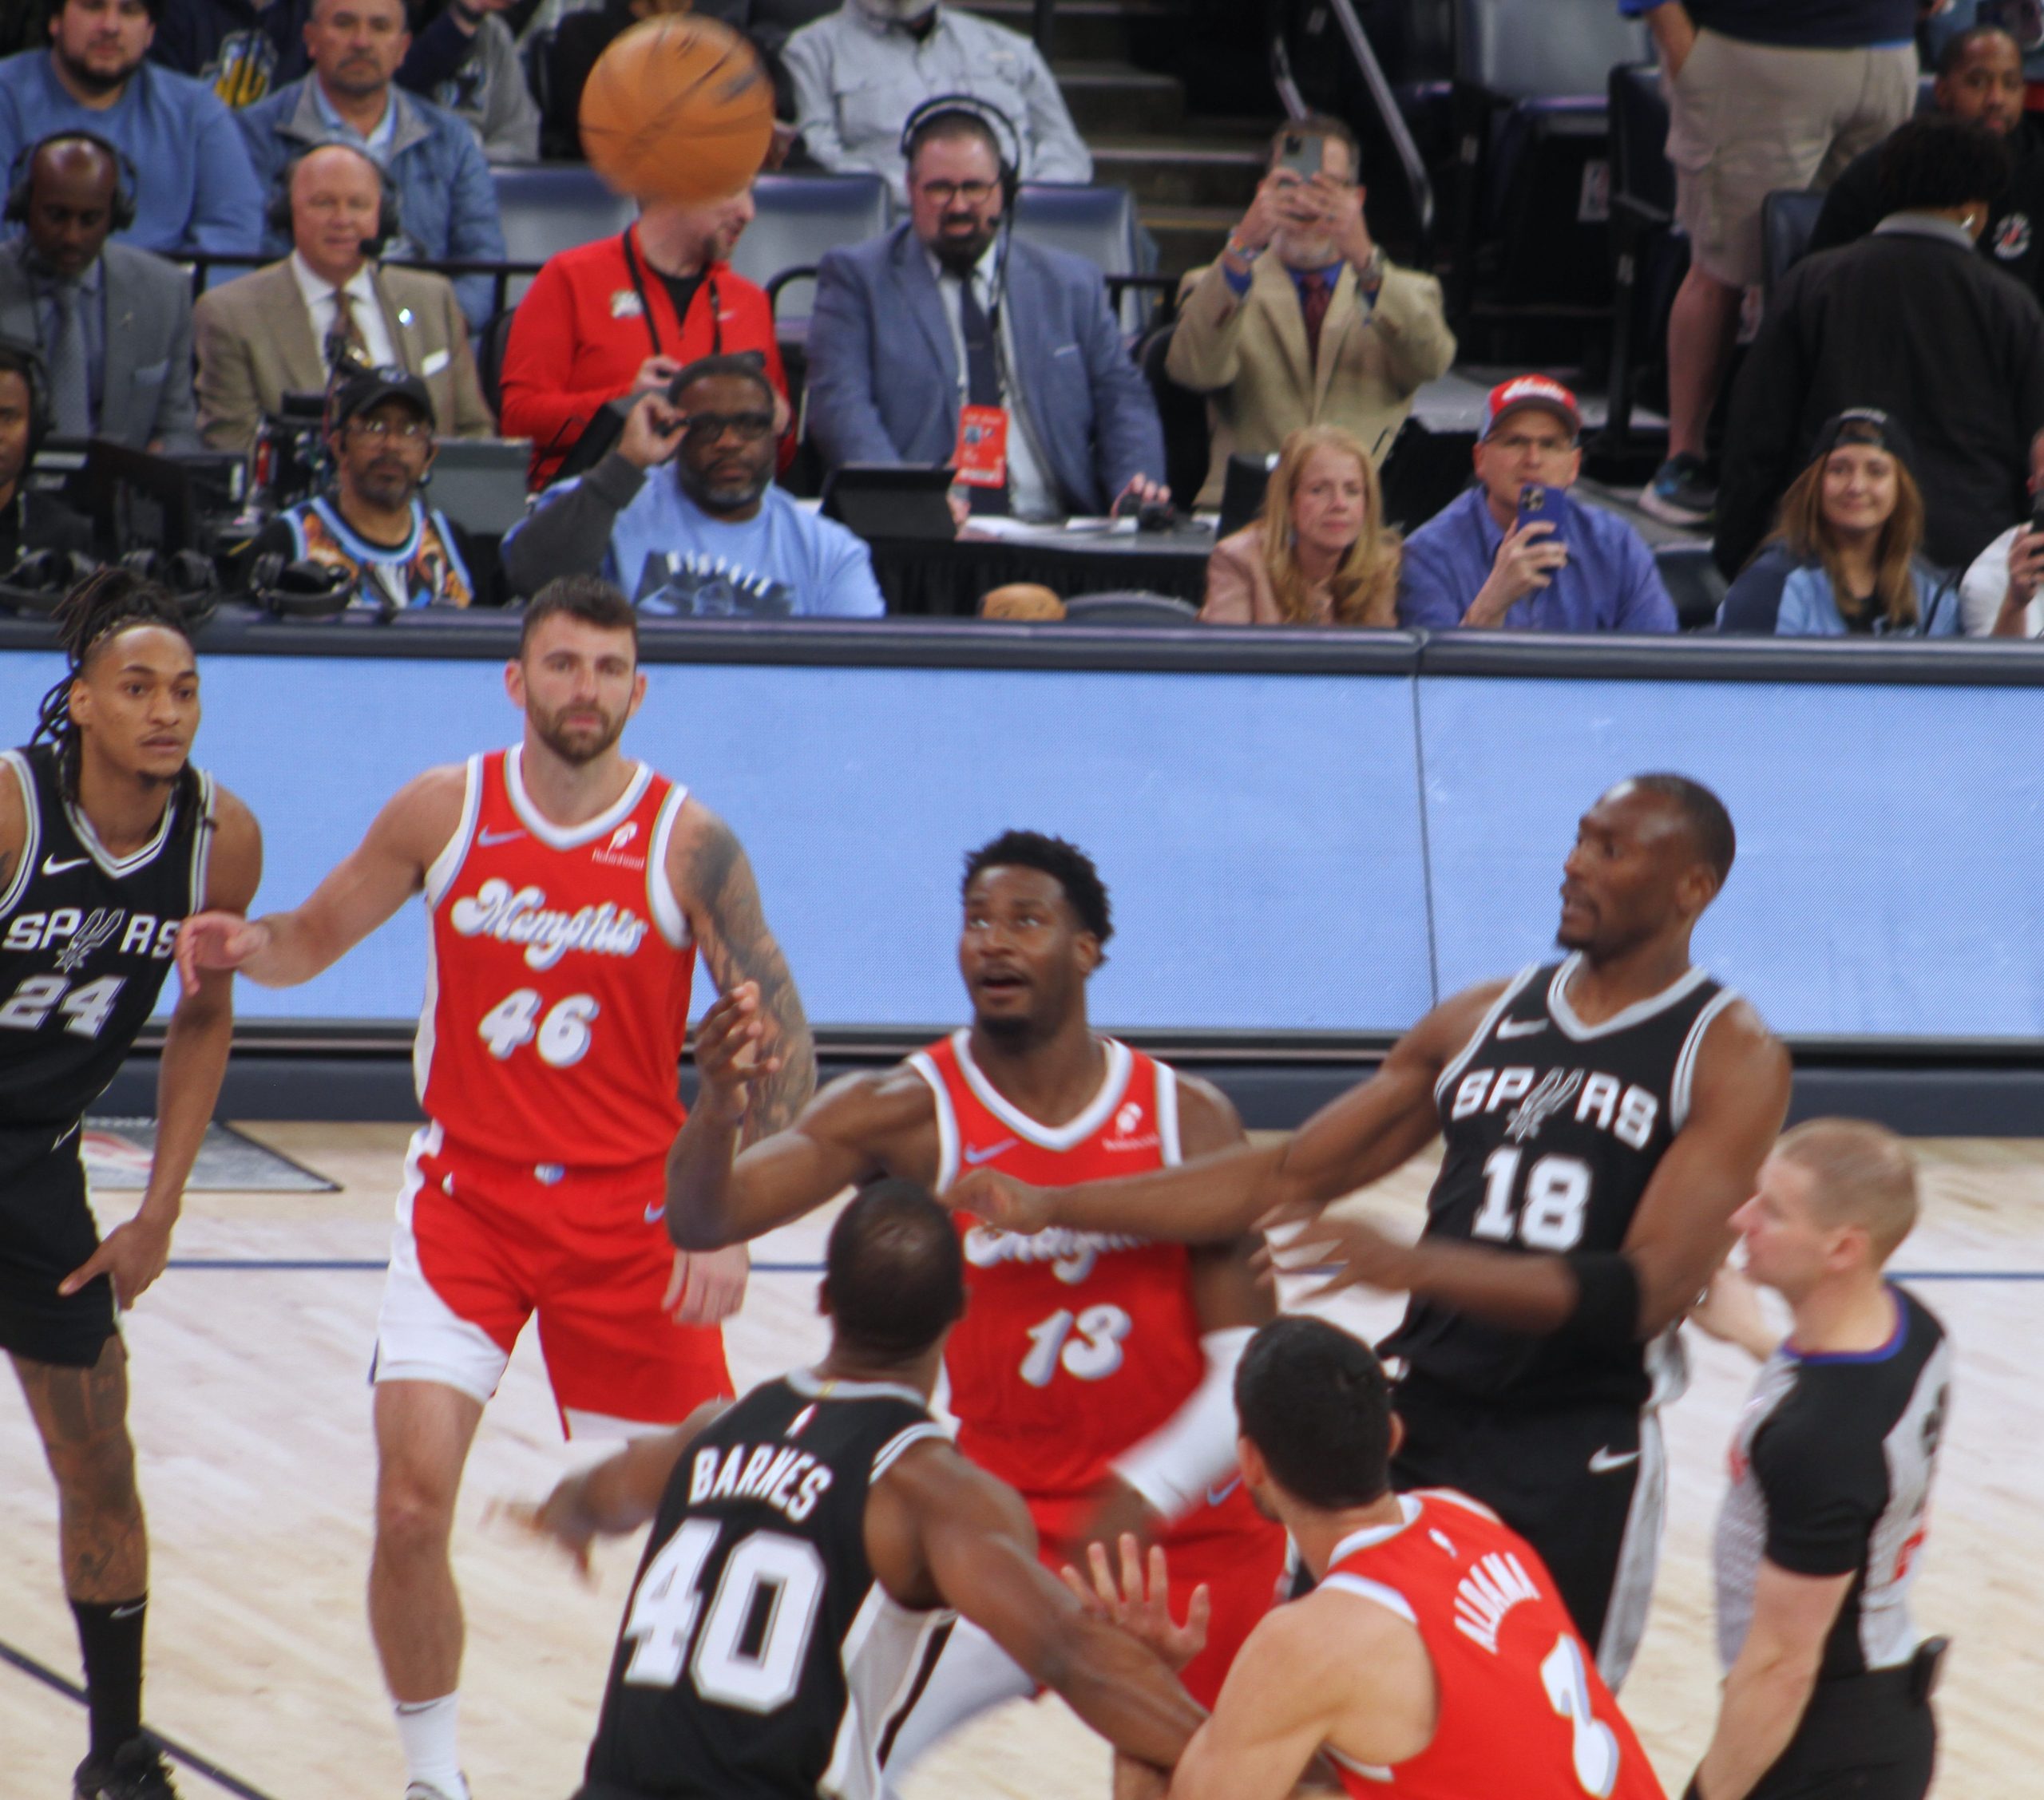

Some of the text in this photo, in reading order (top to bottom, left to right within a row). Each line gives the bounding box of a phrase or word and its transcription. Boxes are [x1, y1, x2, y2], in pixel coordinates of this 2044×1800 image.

[450, 878, 648, 972] Memphis
[0, 975, 128, 1040] 24
[477, 987, 600, 1068] 46
[1470, 1145, 1594, 1253] 18
[1018, 1303, 1133, 1388] 13
[688, 1443, 834, 1524] BARNES
[622, 1517, 827, 1717] 40
